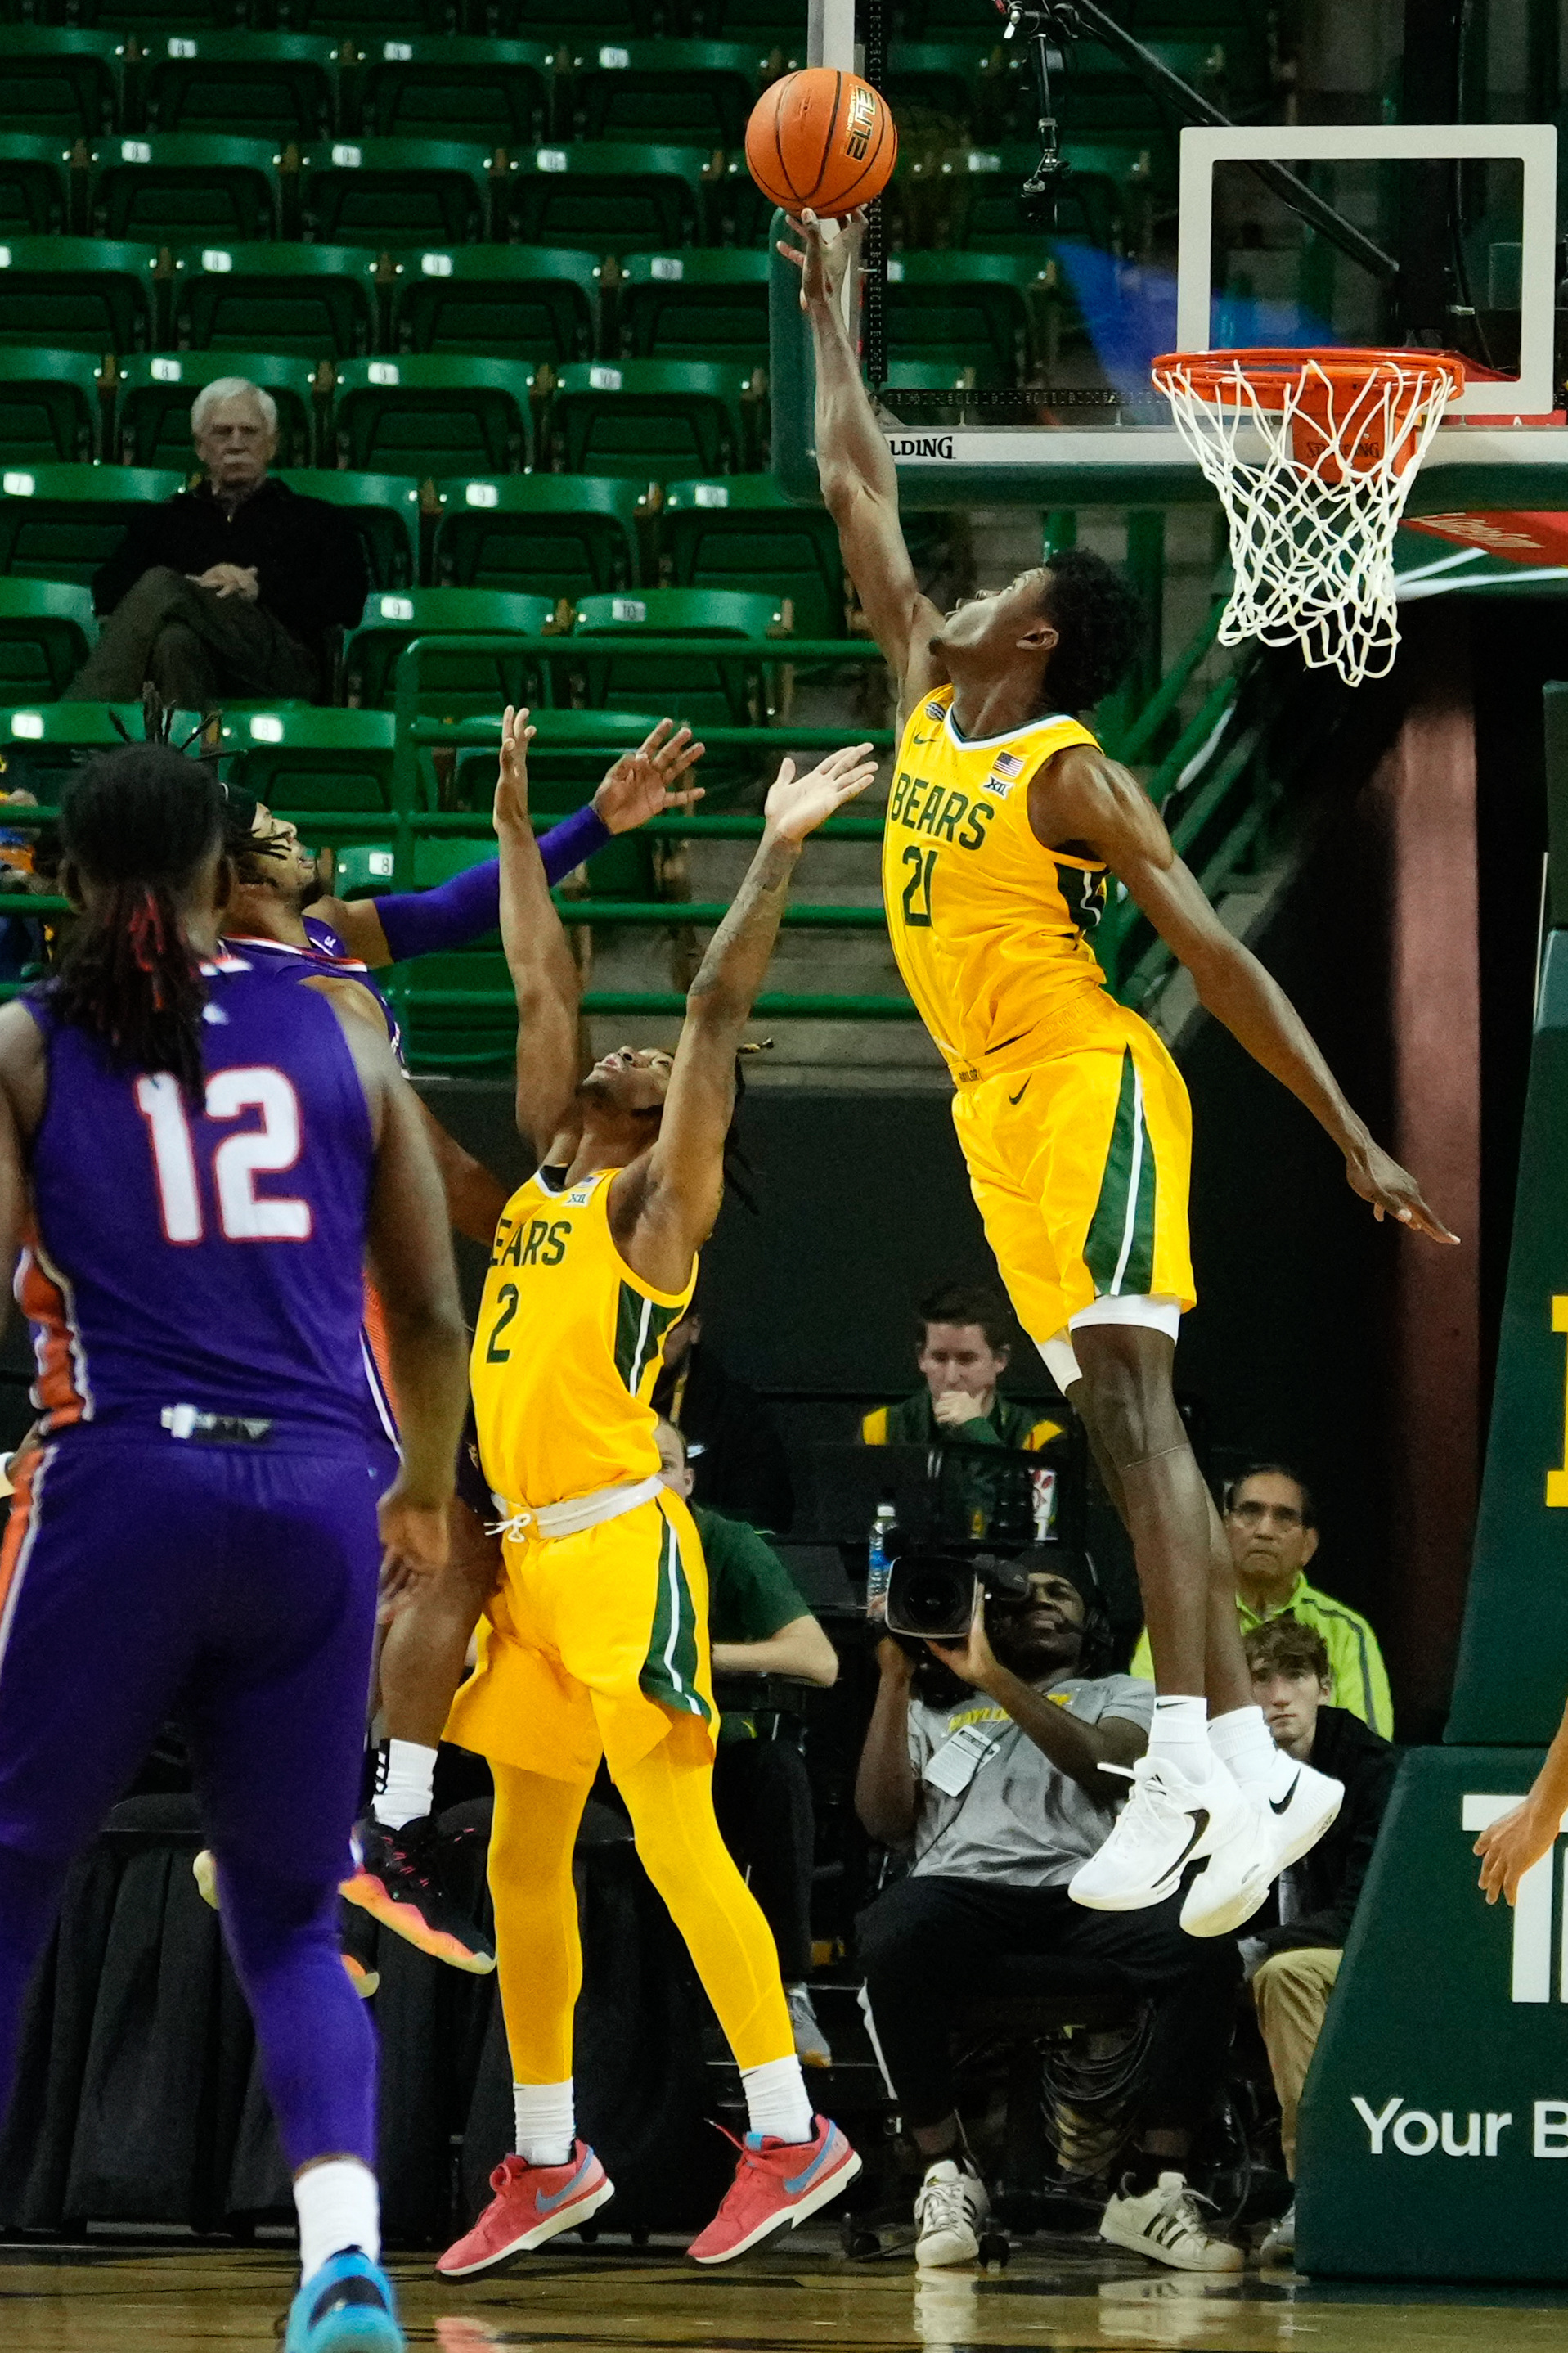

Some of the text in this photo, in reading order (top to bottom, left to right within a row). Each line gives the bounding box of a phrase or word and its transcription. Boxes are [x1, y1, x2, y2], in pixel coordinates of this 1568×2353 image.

[891, 772, 995, 851] BEARS
[902, 845, 939, 928] 21
[136, 1065, 312, 1245] 12
[486, 1283, 520, 1364] 2
[1462, 1794, 1568, 2003] T
[1351, 2097, 1512, 2157] Your
